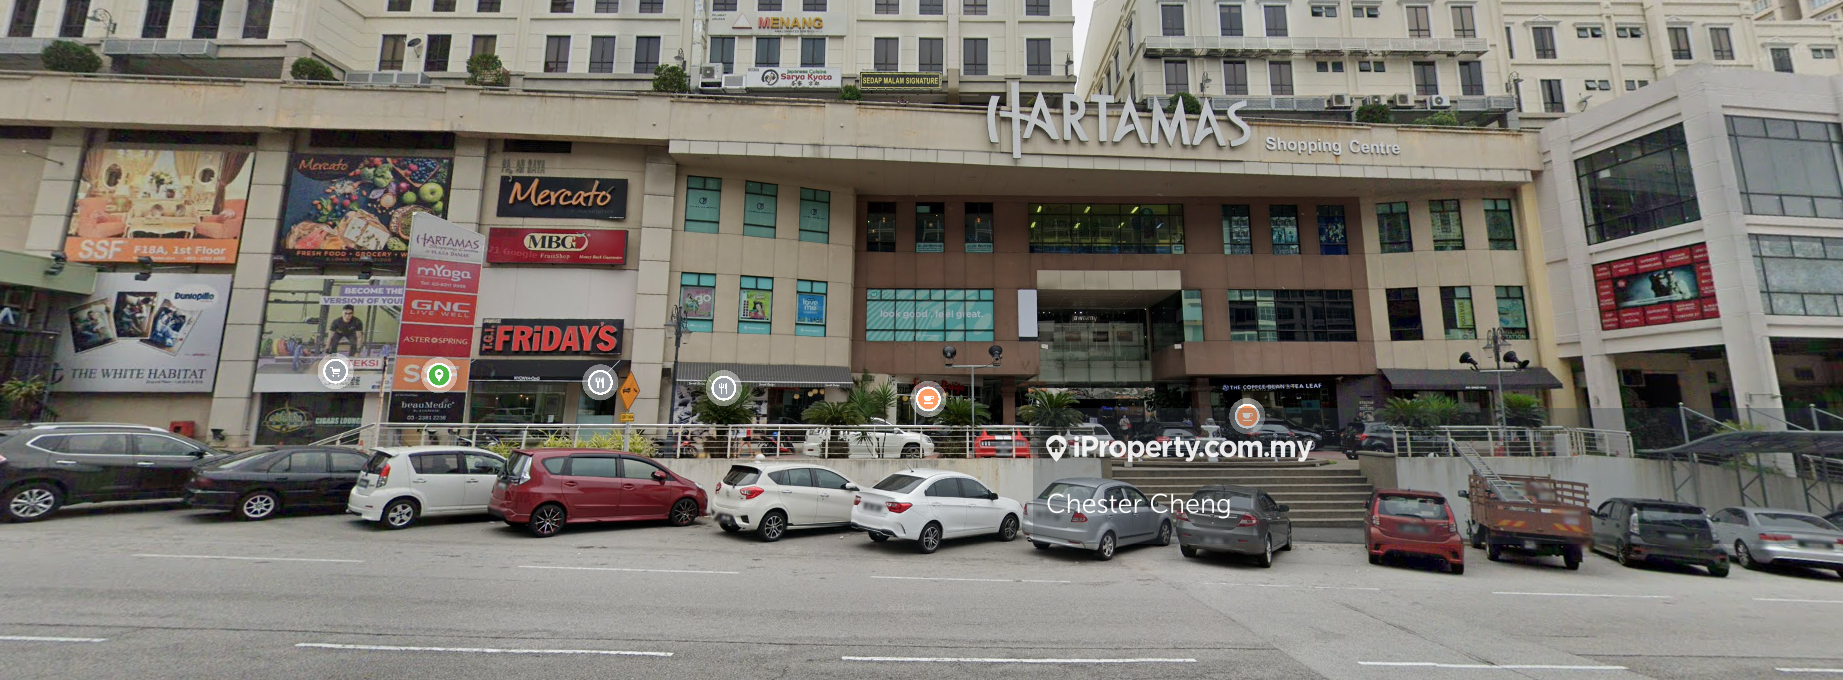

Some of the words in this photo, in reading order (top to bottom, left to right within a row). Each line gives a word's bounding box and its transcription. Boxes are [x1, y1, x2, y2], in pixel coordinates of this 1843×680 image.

[758, 16, 824, 29] MENANG
[780, 73, 805, 81] Saryo
[807, 73, 833, 82] Kyoto
[862, 76, 882, 84] SEDAP
[905, 76, 939, 85] SIGNATURE
[987, 79, 1251, 159] HARTAMAS
[1265, 136, 1341, 156] Shopping
[1349, 139, 1401, 155] Centre
[298, 157, 349, 172] Mercato
[508, 178, 613, 207] Mercato
[416, 233, 480, 250] HARTAMAS
[528, 234, 578, 250] MBG
[78, 238, 124, 260] SSF
[172, 245, 191, 255] 1st
[195, 245, 226, 255] Floor
[417, 264, 472, 282] mYoga
[174, 291, 215, 302] Dunlopillo
[344, 287, 384, 295] BECOME
[386, 287, 404, 295] THE
[694, 294, 712, 305] go
[411, 299, 471, 313] GNC
[880, 309, 901, 318] look
[903, 309, 928, 319] good
[935, 309, 954, 318] feel
[956, 310, 984, 319] great.
[438, 337, 468, 345] SPRING
[482, 324, 496, 351] T.G.I.
[347, 359, 379, 367] TEKSI
[70, 368, 97, 379] THE
[101, 368, 145, 379] WHITE
[147, 368, 207, 379] HABITAT
[401, 400, 453, 409] beauMedic
[315, 417, 339, 425] CIGARS
